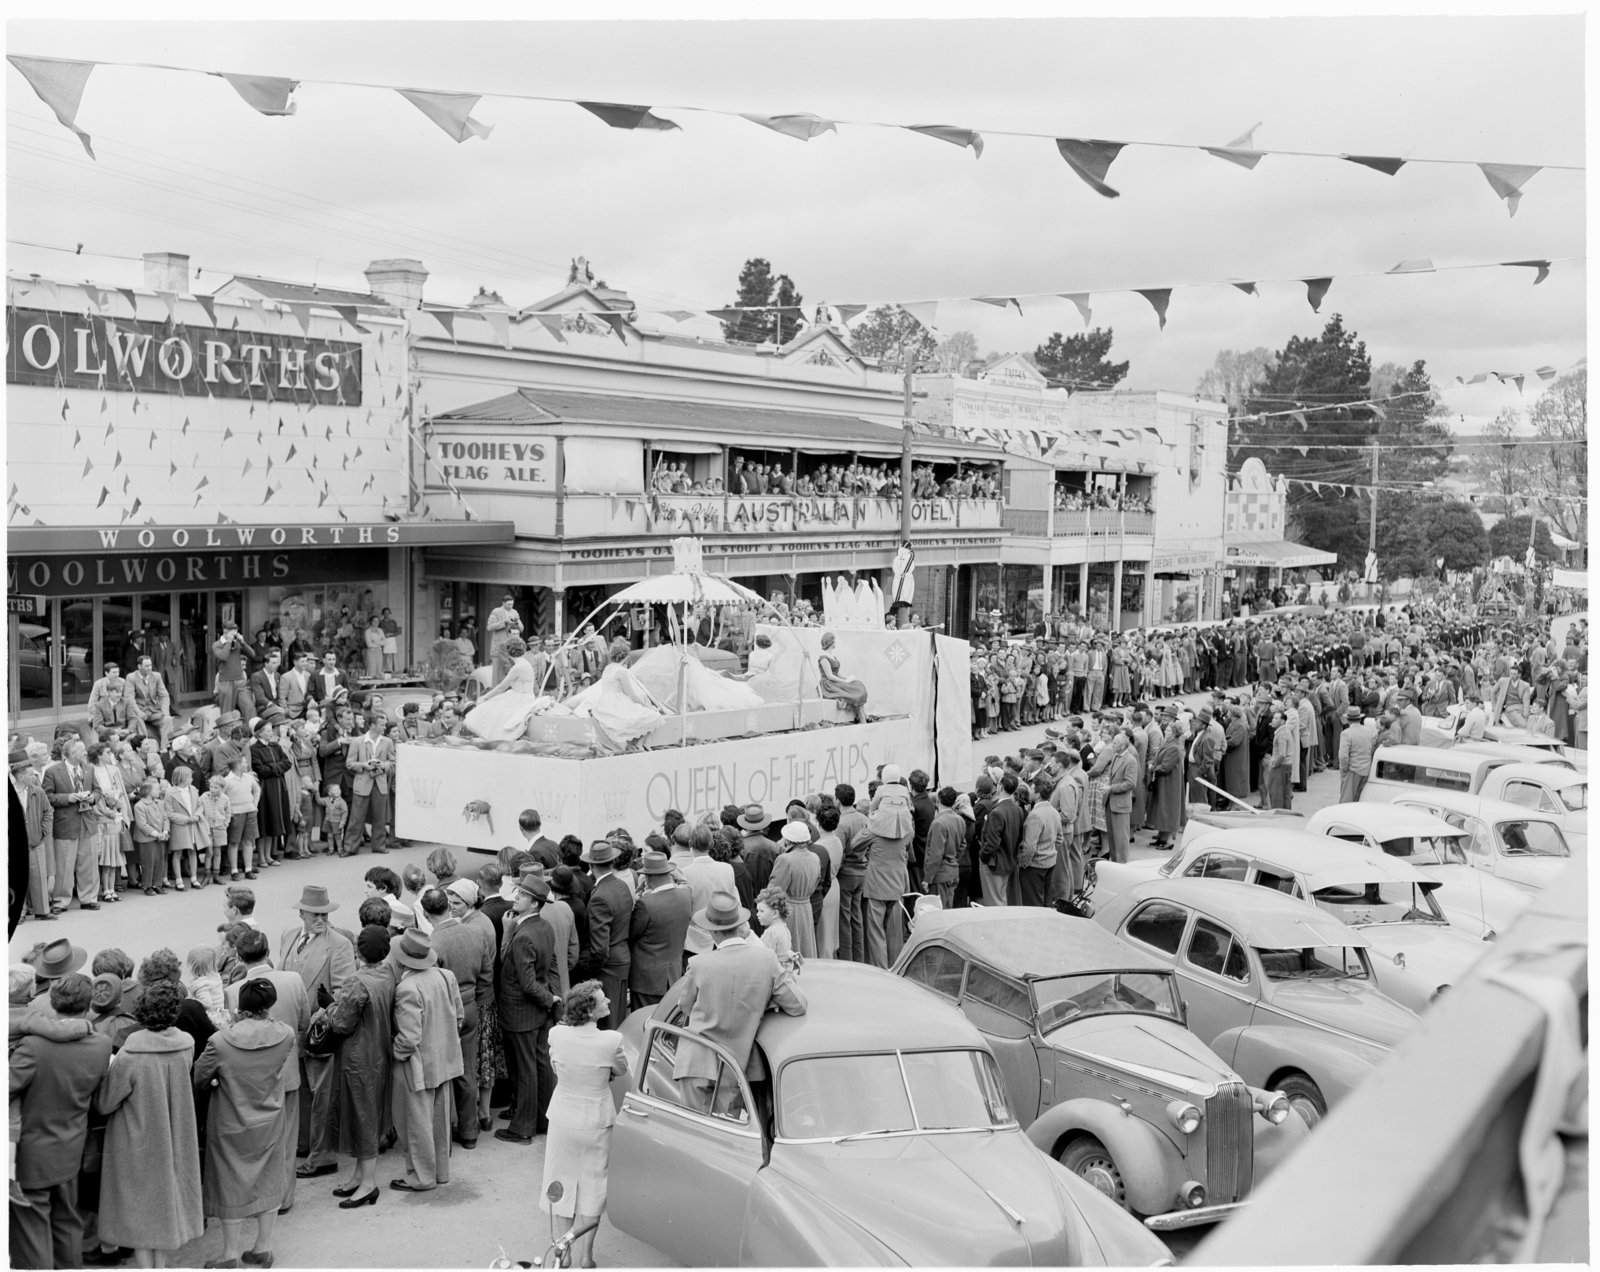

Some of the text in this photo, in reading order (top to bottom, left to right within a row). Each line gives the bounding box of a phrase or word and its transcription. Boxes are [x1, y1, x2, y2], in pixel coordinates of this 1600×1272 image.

[7, 324, 340, 392] OLWORTHS
[438, 441, 545, 462] TOOHEYS
[443, 464, 546, 483] FLAG ALE.
[734, 502, 866, 523] AUSTRALIAN
[99, 526, 401, 549] WOOLWORTHS
[567, 547, 645, 559] TOOHEYS
[720, 544, 760, 553] STOUT
[781, 542, 830, 551] TOOHEYS
[909, 538, 947, 546] OOHEYS
[646, 762, 737, 822] QUEEN
[749, 757, 781, 803] OF
[786, 754, 815, 798] THE
